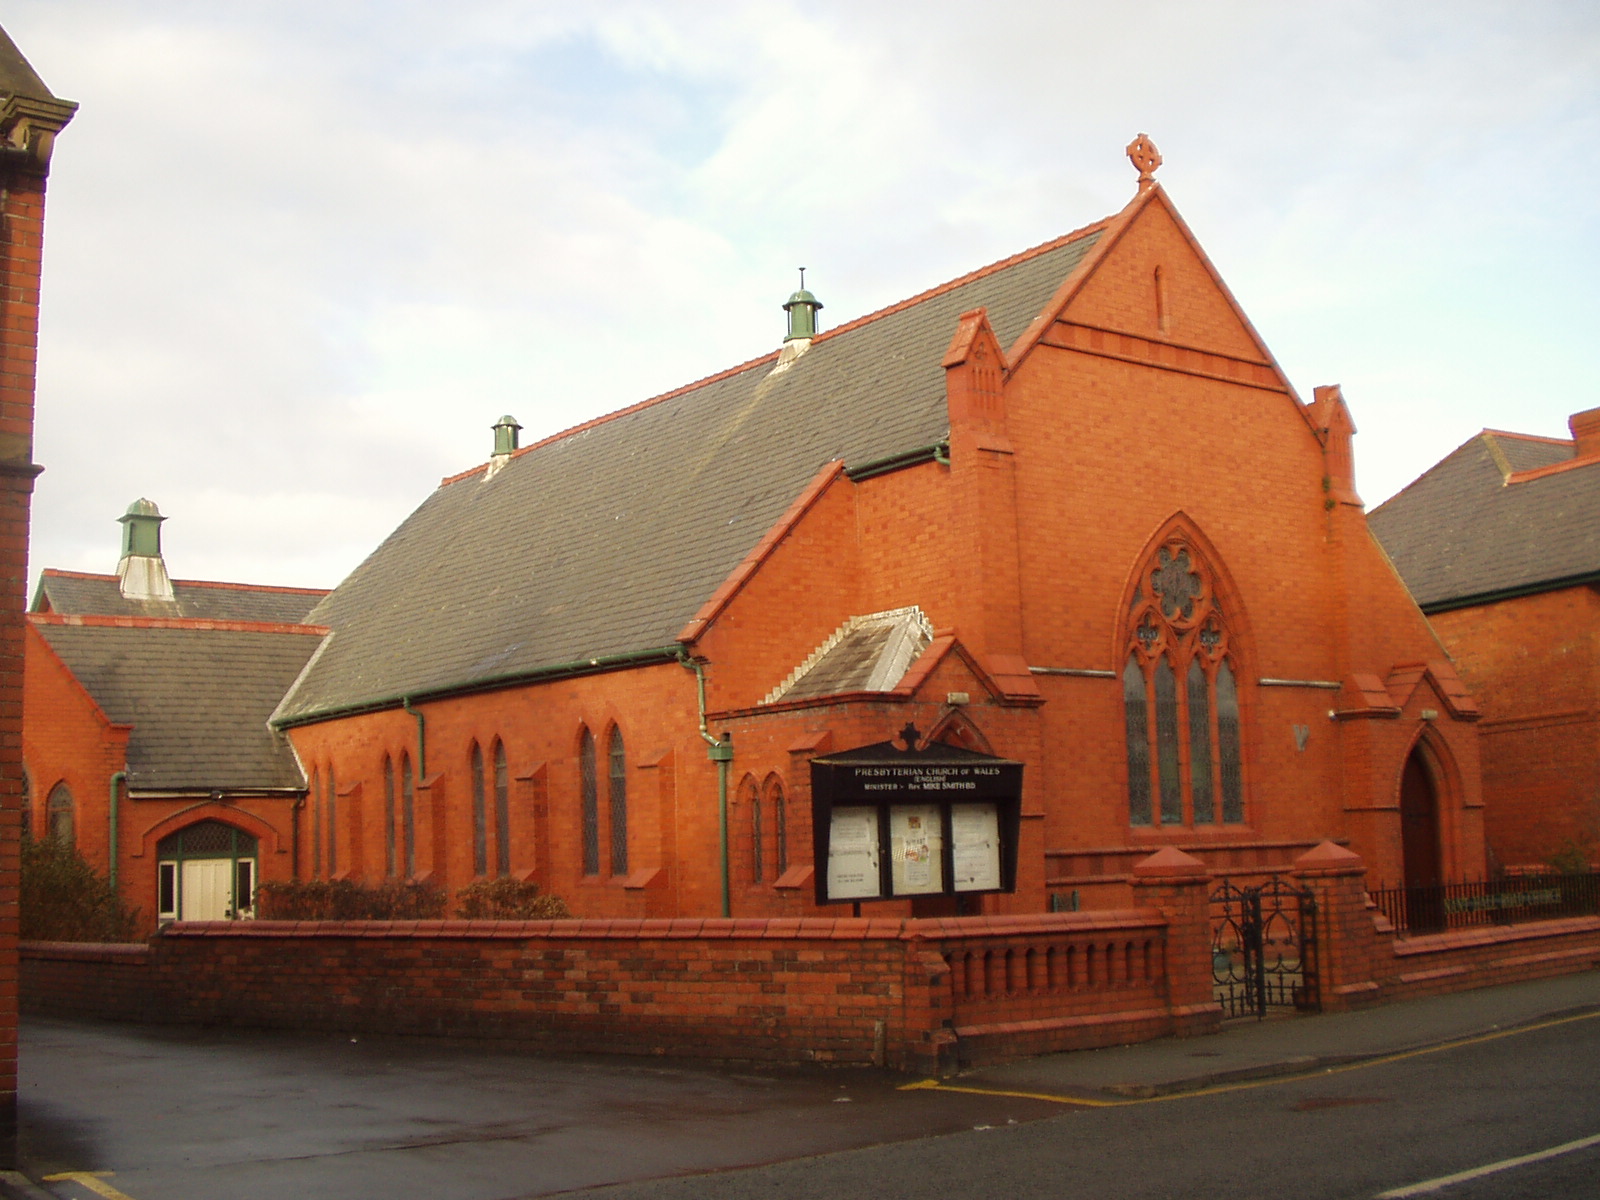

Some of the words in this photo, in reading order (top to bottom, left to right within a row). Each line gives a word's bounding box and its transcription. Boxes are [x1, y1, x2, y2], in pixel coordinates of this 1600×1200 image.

[855, 768, 923, 776] PRESBYTERIAN
[926, 768, 958, 776] CHURCH
[974, 767, 1000, 775] WALES
[923, 782, 941, 790] MIKE
[941, 782, 965, 790] SMITH
